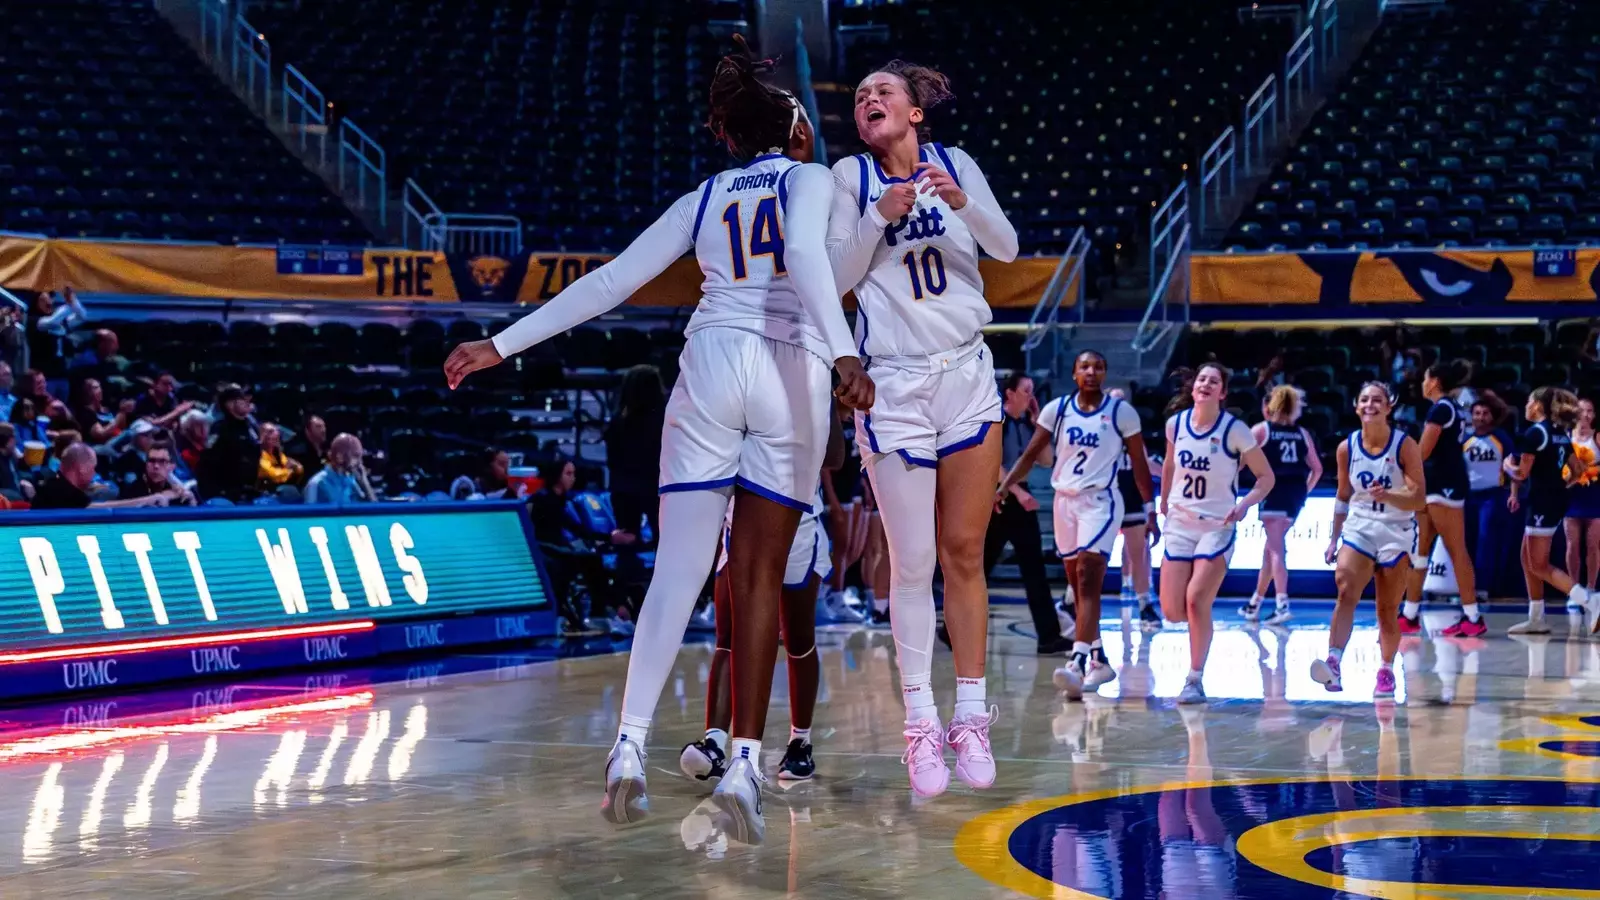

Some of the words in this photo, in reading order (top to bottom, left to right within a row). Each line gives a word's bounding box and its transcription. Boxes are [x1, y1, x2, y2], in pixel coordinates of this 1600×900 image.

[727, 171, 780, 193] JORDAN
[722, 196, 788, 282] 14
[372, 255, 434, 296] THE
[538, 258, 607, 300] ZO
[903, 246, 948, 300] 10
[1066, 426, 1100, 449] Pitt
[1073, 451, 1088, 475] 2
[1178, 450, 1211, 472] Pitt
[1280, 440, 1299, 463] 21
[1469, 446, 1497, 463] Pitt
[1183, 476, 1207, 500] 20
[1356, 470, 1393, 490] Ptt
[19, 531, 218, 634] PITT
[255, 522, 429, 615] WINS
[404, 624, 444, 648] UPMC
[191, 646, 241, 674] UPMC
[303, 637, 348, 662] UPMC
[62, 660, 118, 689] UPMC
